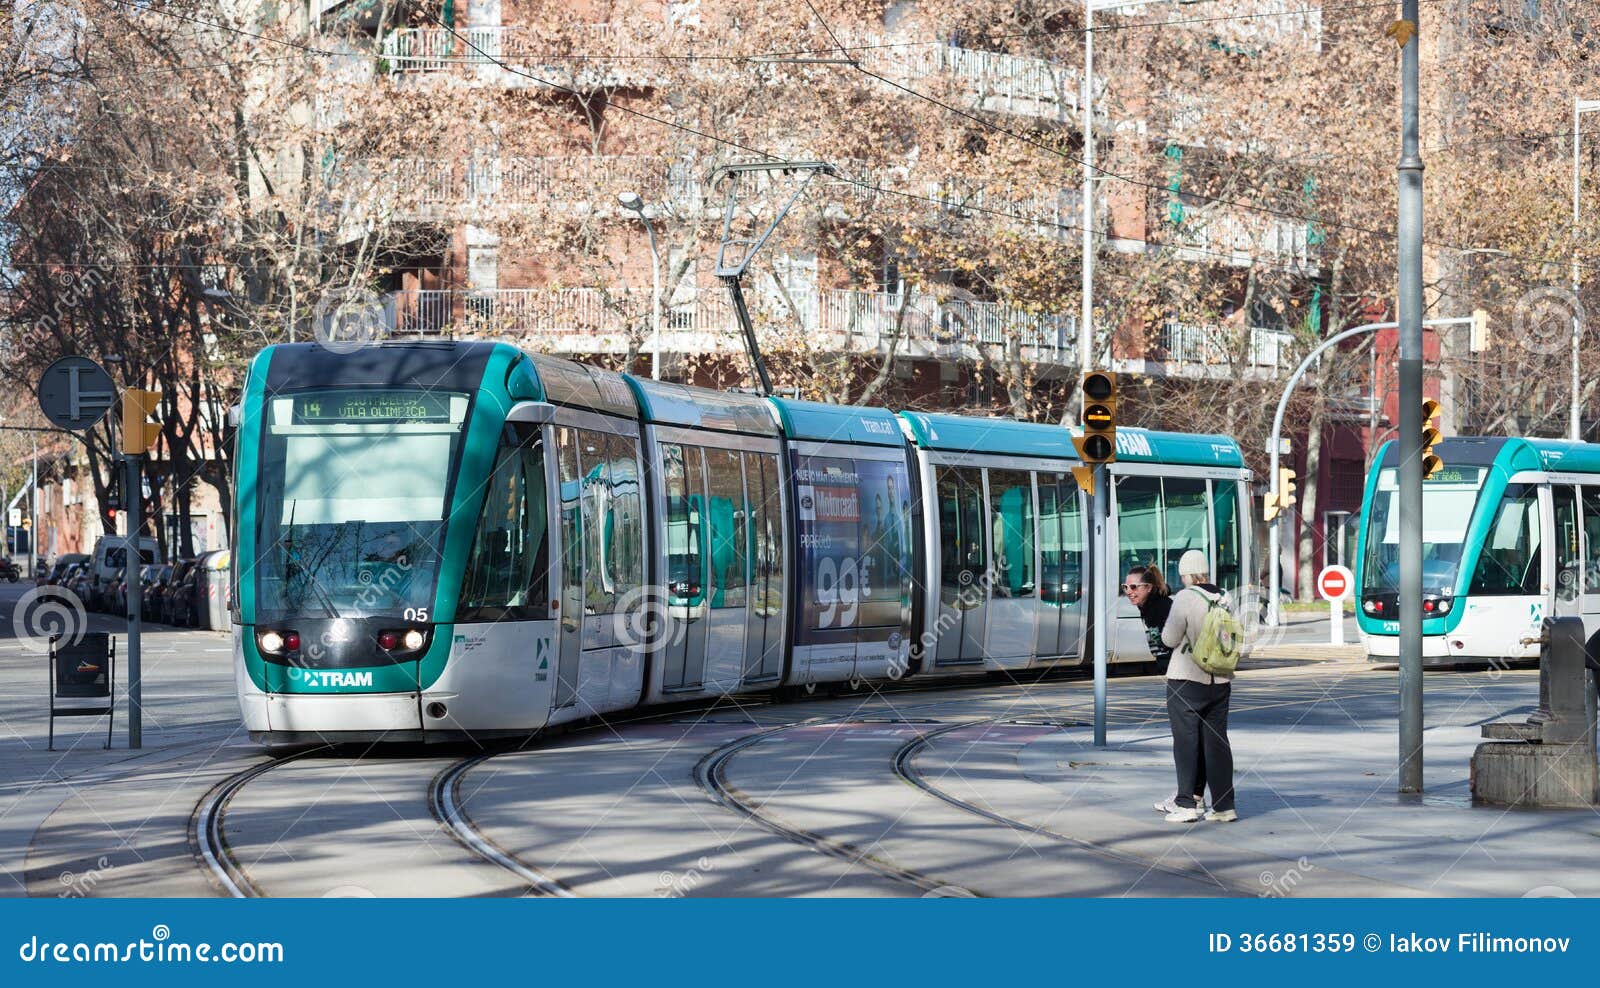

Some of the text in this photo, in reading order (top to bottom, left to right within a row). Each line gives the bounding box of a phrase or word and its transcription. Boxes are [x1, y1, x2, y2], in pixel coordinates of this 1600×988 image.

[339, 406, 366, 417] VILA
[860, 416, 894, 435] tram.cat
[1115, 432, 1152, 456] TRAM
[815, 490, 859, 518] Motorcraft
[403, 607, 429, 623] 05
[319, 672, 373, 687] TRAM
